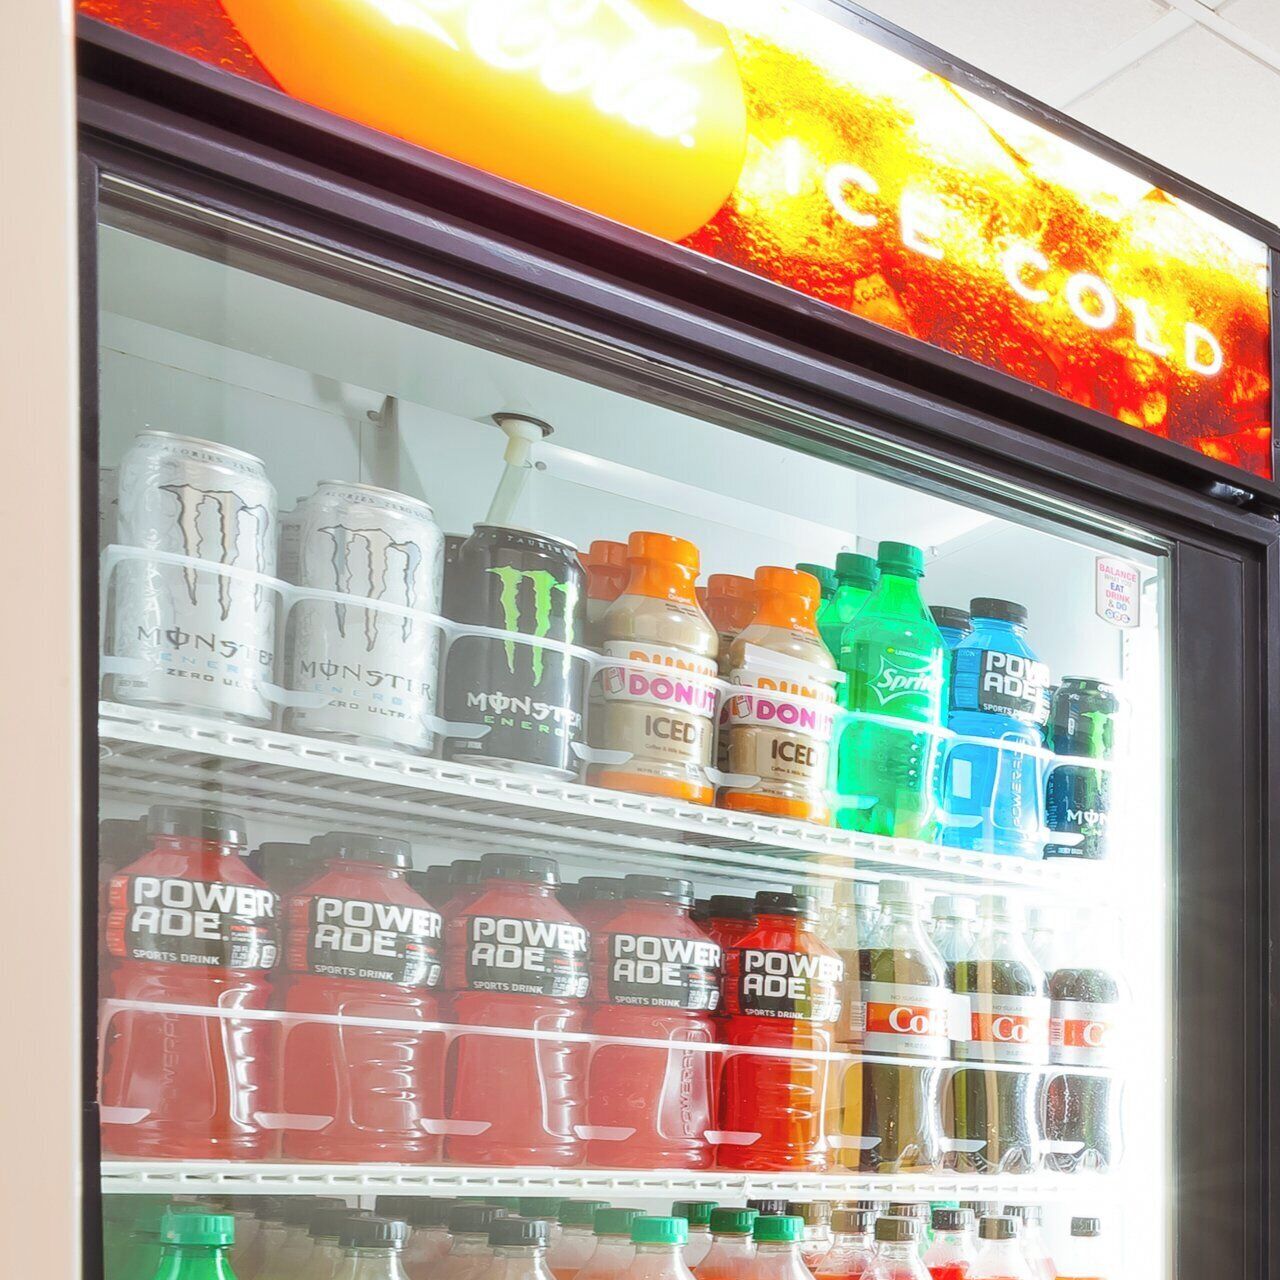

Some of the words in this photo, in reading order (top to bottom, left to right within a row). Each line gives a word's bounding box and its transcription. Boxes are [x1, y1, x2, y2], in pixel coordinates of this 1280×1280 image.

[780, 137, 945, 259] ICE
[1002, 240, 1224, 377] COLD
[1099, 563, 1136, 582] BALANCE
[1111, 583, 1124, 592] EAT
[1106, 590, 1130, 603] DRINK
[1116, 602, 1127, 610] DO
[467, 692, 581, 730] MONSTER
[484, 715, 574, 739] ENERGY
[645, 716, 696, 744] ICED
[134, 877, 274, 918] POWER
[317, 897, 442, 938] POWER
[473, 917, 587, 952] POWER
[133, 949, 177, 962] SPORTS
[181, 953, 219, 965] DRINK
[614, 935, 721, 967] POWER
[745, 950, 844, 982] POWER
